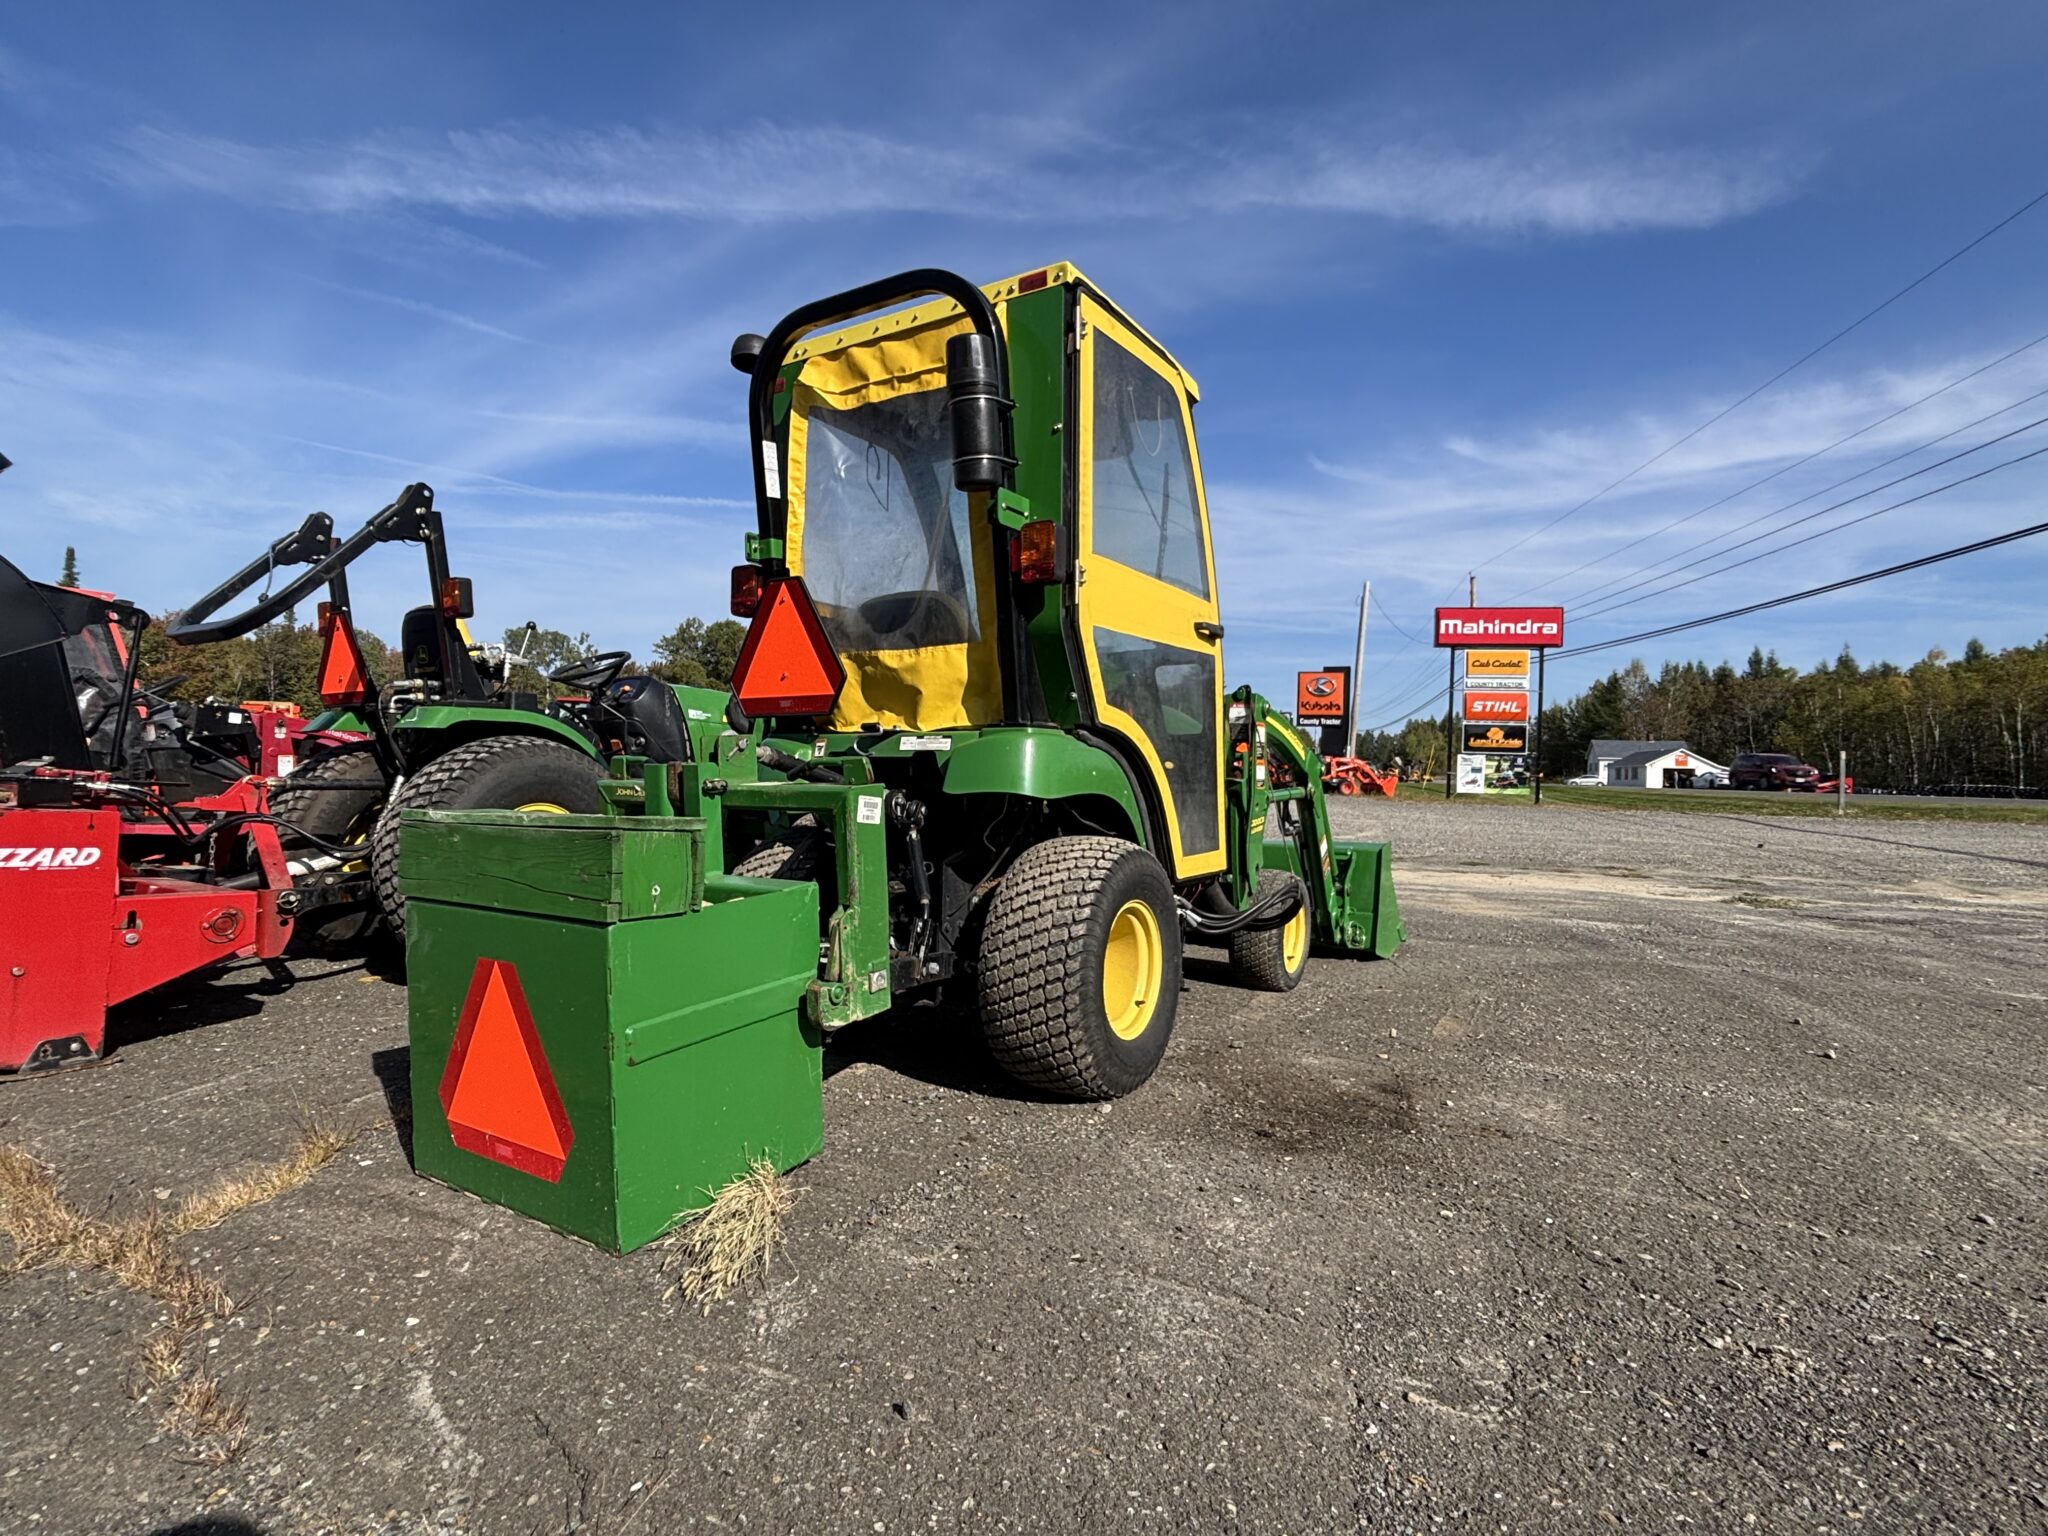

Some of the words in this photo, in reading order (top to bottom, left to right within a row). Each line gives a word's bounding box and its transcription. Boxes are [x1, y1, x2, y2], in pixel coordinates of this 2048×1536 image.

[1439, 619, 1558, 635] Mahindra
[1471, 659, 1491, 668] Cub
[1491, 659, 1524, 668] Cadet
[1301, 701, 1341, 711] Kubota
[1471, 701, 1522, 713] STIHL
